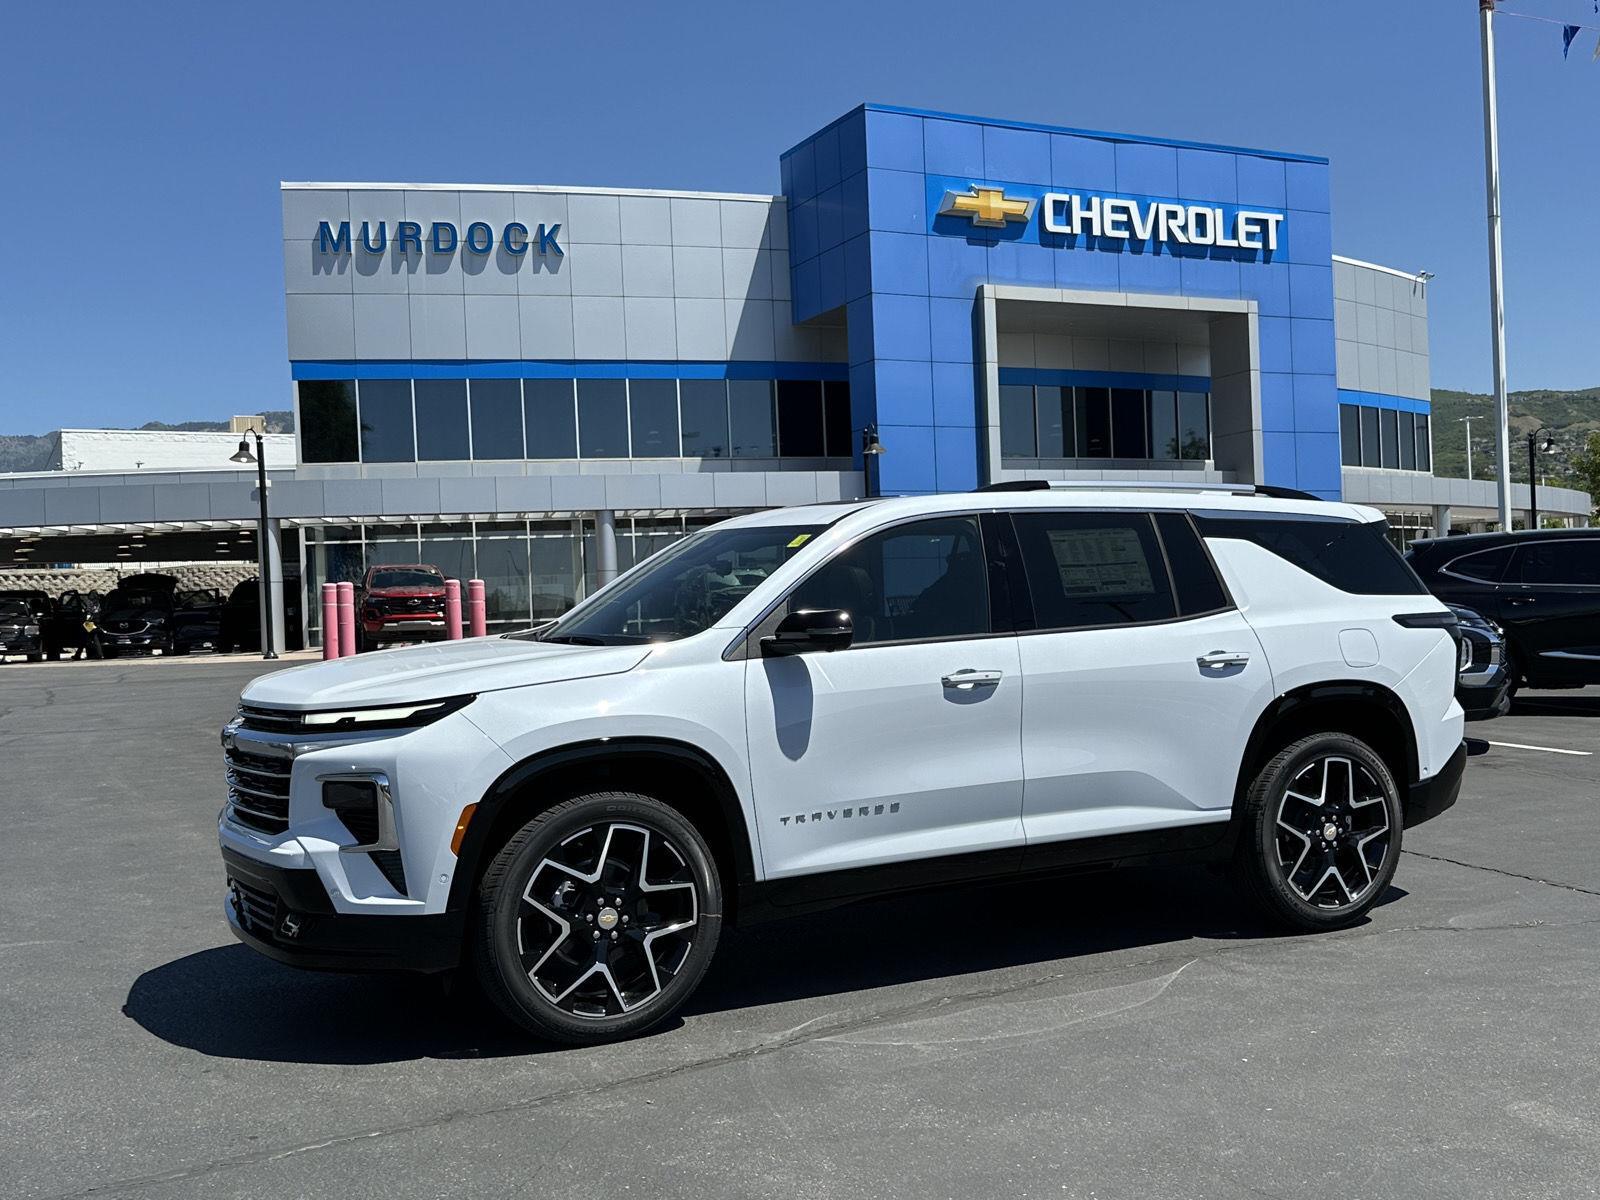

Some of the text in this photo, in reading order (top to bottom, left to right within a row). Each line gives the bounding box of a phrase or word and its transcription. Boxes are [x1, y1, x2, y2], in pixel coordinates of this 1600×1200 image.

[319, 220, 565, 256] MURDOCK
[1044, 192, 1284, 250] CHEVROLET
[779, 802, 900, 826] TRAVERSE
